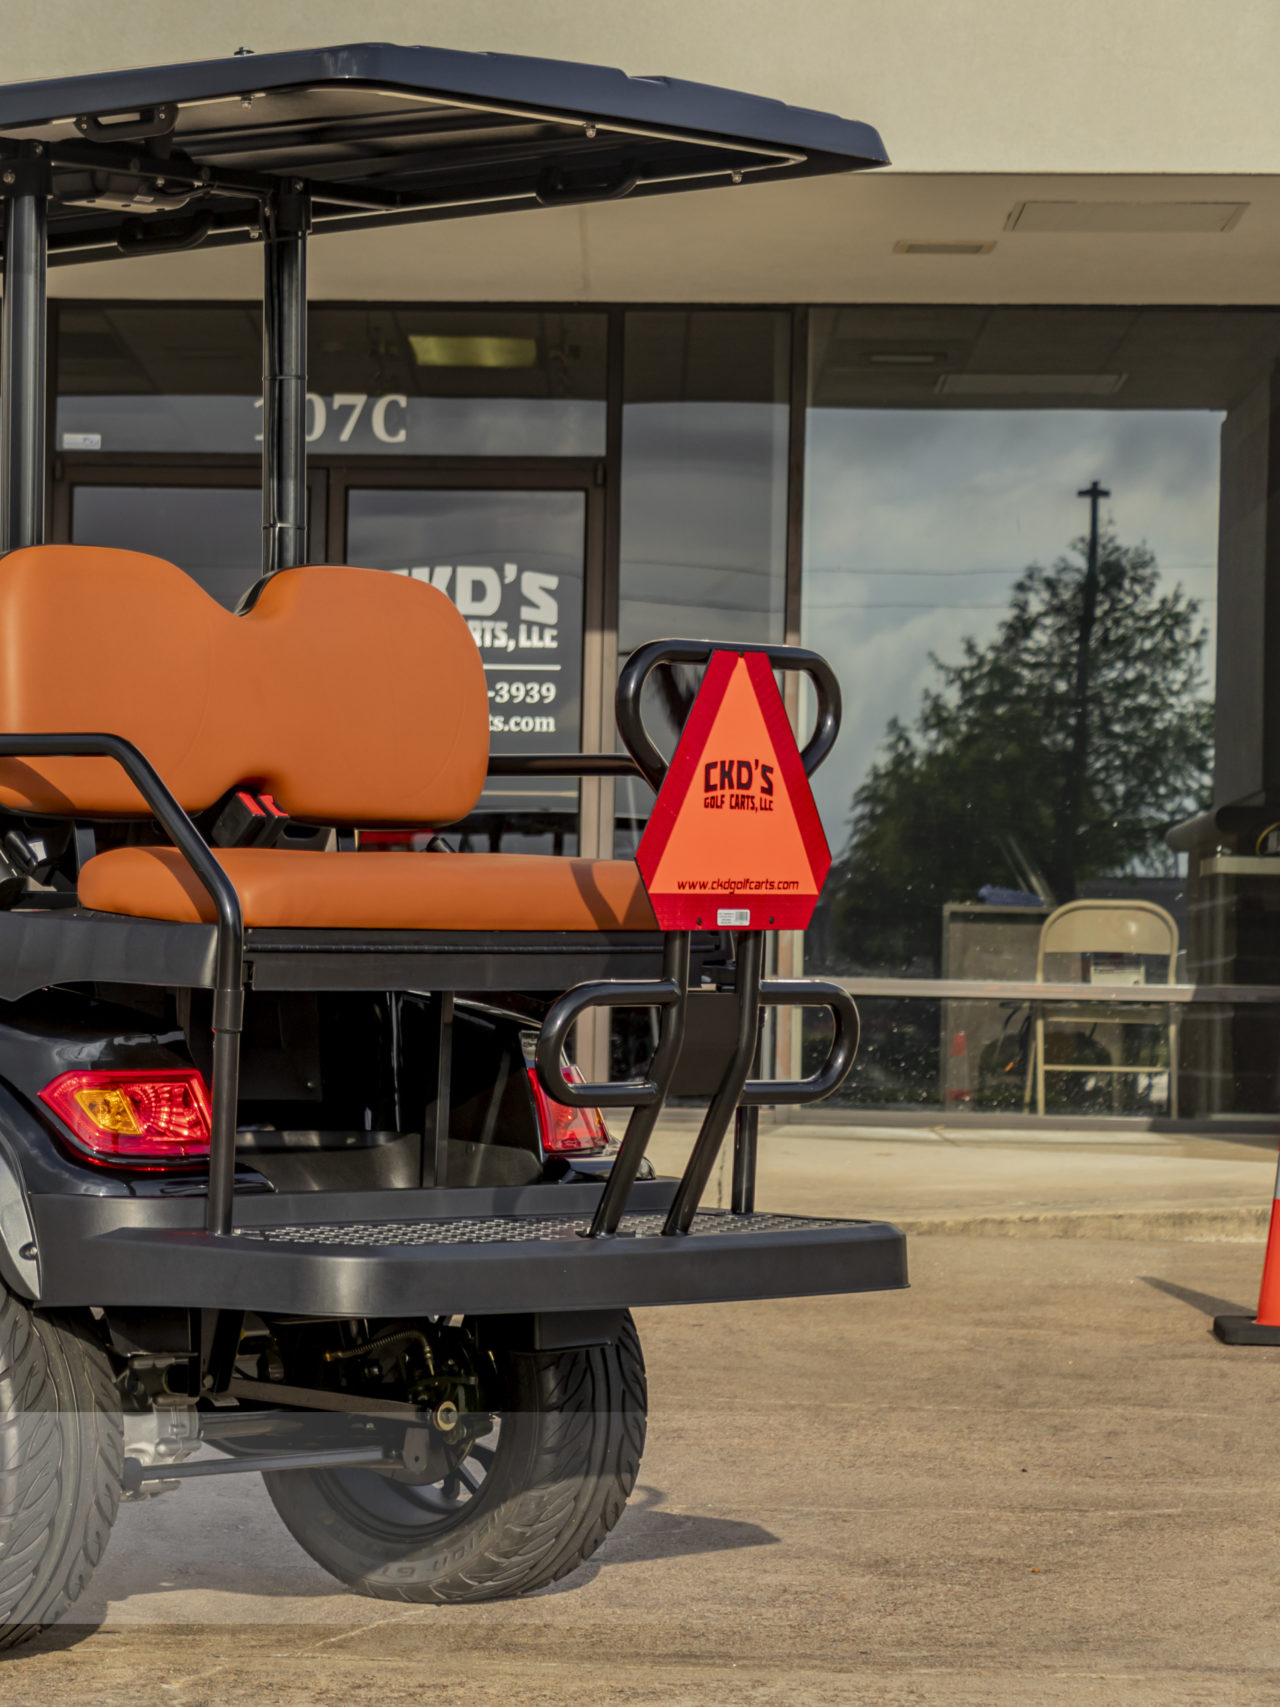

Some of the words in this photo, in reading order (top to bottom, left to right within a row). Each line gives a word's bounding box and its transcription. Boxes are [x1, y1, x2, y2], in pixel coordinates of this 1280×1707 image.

[254, 392, 407, 443] 07C
[467, 619, 516, 652] RTS,
[518, 623, 558, 649] LLC
[704, 759, 774, 797] CKD'S
[704, 795, 725, 809] GOLF
[730, 794, 758, 813] CARTS,
[760, 797, 774, 811] LLC
[677, 878, 799, 895] www.ckdgolfcarts.com
